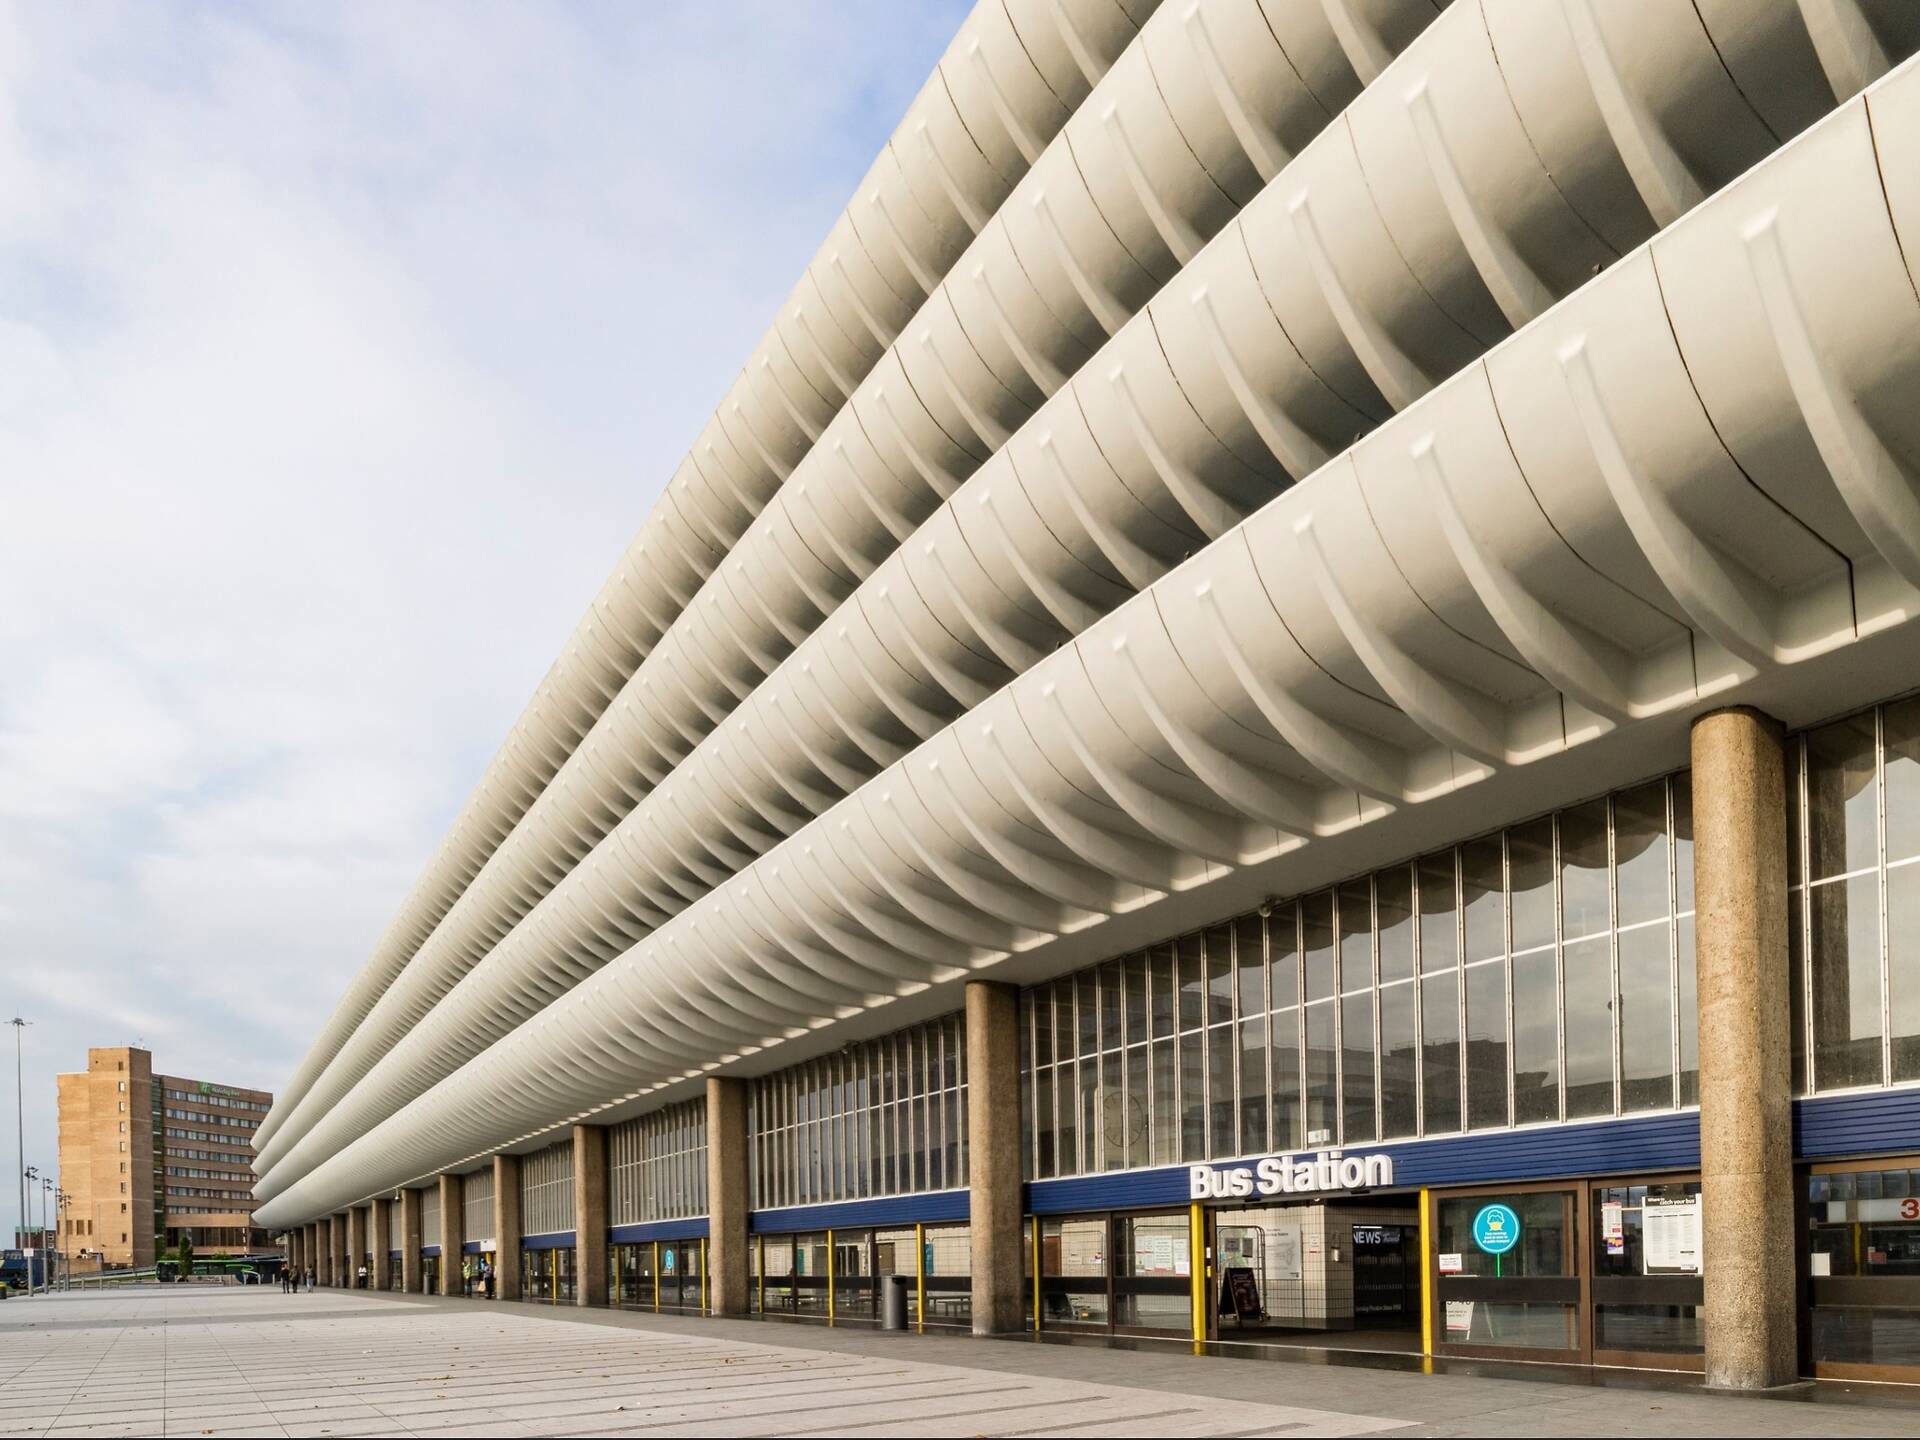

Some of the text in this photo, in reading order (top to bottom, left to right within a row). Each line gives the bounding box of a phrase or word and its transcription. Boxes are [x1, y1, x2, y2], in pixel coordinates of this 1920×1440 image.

[1190, 1151, 1393, 1199] Bus Station
[1900, 1198, 1920, 1219] 3
